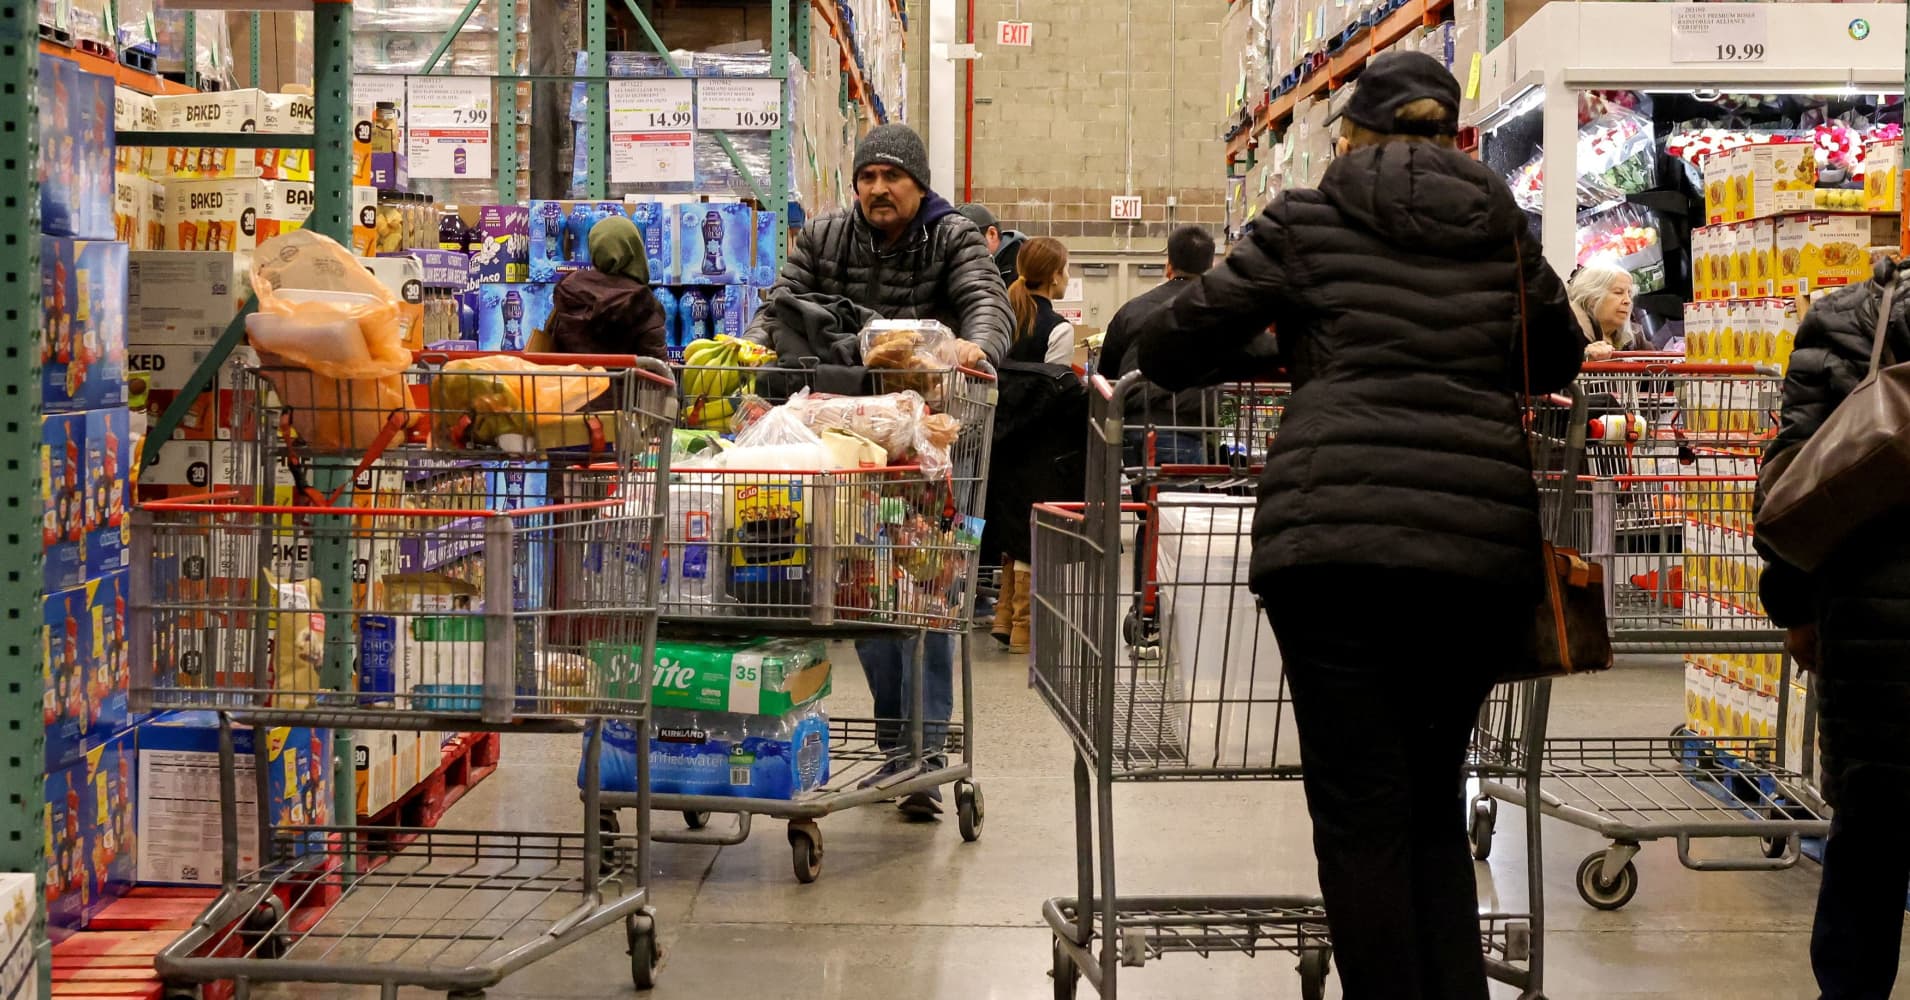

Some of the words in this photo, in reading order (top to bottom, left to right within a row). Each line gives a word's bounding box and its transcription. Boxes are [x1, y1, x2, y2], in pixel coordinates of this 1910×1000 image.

[1002, 24, 1029, 45] EXIT
[1716, 43, 1764, 60] 19.99
[186, 103, 221, 122] BAKED
[290, 101, 314, 120] BAK
[453, 109, 487, 124] 7.99
[648, 112, 691, 127] 14.99
[736, 111, 778, 126] 10.99
[359, 125, 369, 136] 30
[190, 191, 223, 209] BAKED
[363, 210, 375, 221] 30
[1115, 199, 1139, 217] EXIT
[245, 213, 256, 226] 30
[406, 284, 419, 296] 30
[465, 273, 500, 293] abuloso
[128, 355, 165, 371] KED
[191, 466, 205, 478] 30
[272, 544, 308, 562] AKE
[610, 654, 695, 689] Spite
[735, 665, 757, 681] 35
[661, 728, 705, 739] KIRKLAND
[355, 750, 366, 762] 30
[687, 754, 723, 768] water
